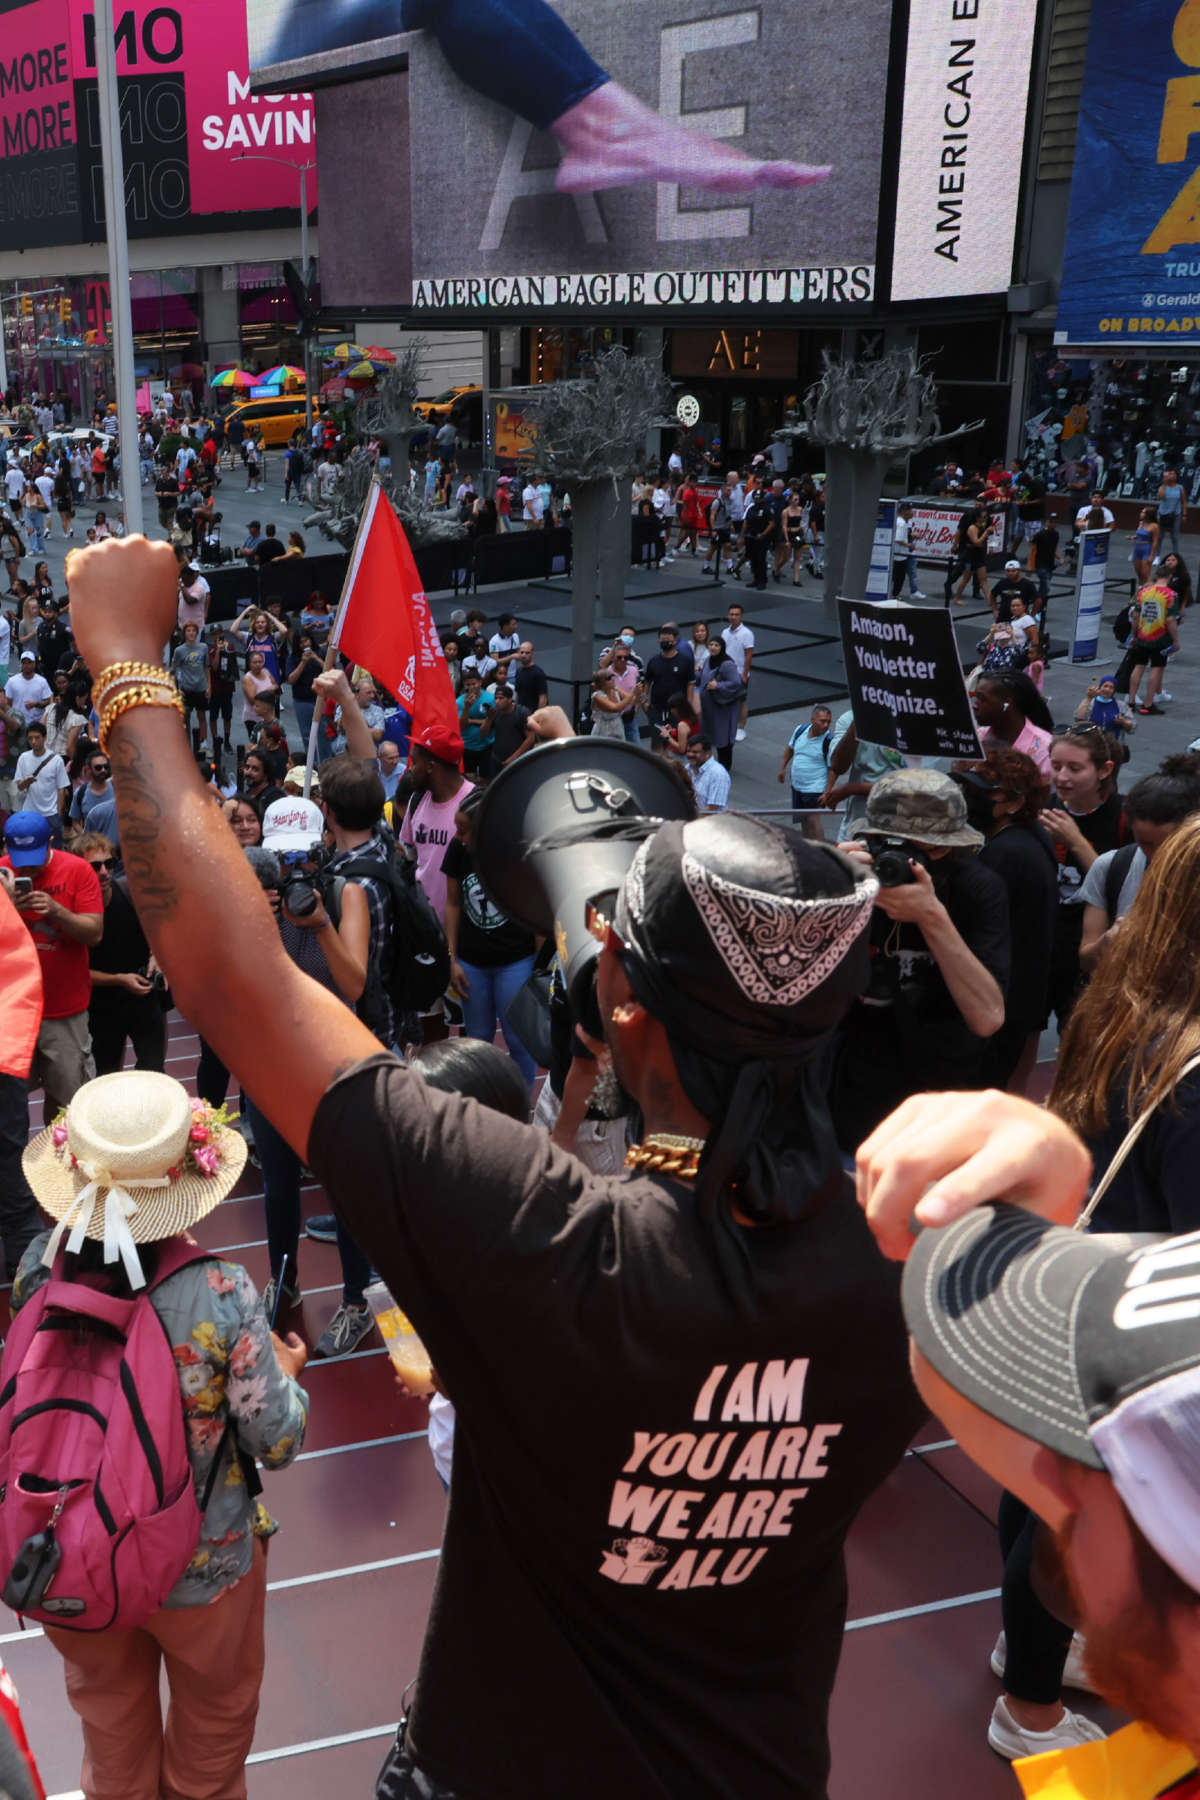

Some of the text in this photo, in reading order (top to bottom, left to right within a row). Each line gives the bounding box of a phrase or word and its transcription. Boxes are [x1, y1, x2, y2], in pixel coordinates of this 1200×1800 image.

[3, 100, 73, 157] MORE
[202, 110, 316, 151] SAVIN
[934, 38, 976, 263] AMERICAN
[413, 266, 871, 309] AMERICAN EAGLE OUTFITTERS
[1098, 318, 1123, 332] ON
[851, 611, 915, 646] Amazon,
[861, 684, 945, 717] recognize.
[429, 830, 449, 846] ALU
[693, 1358, 810, 1422] I AM
[622, 1423, 842, 1481] YOU ARE
[607, 1480, 809, 1540] WE ARE
[657, 1547, 768, 1591] ALU
